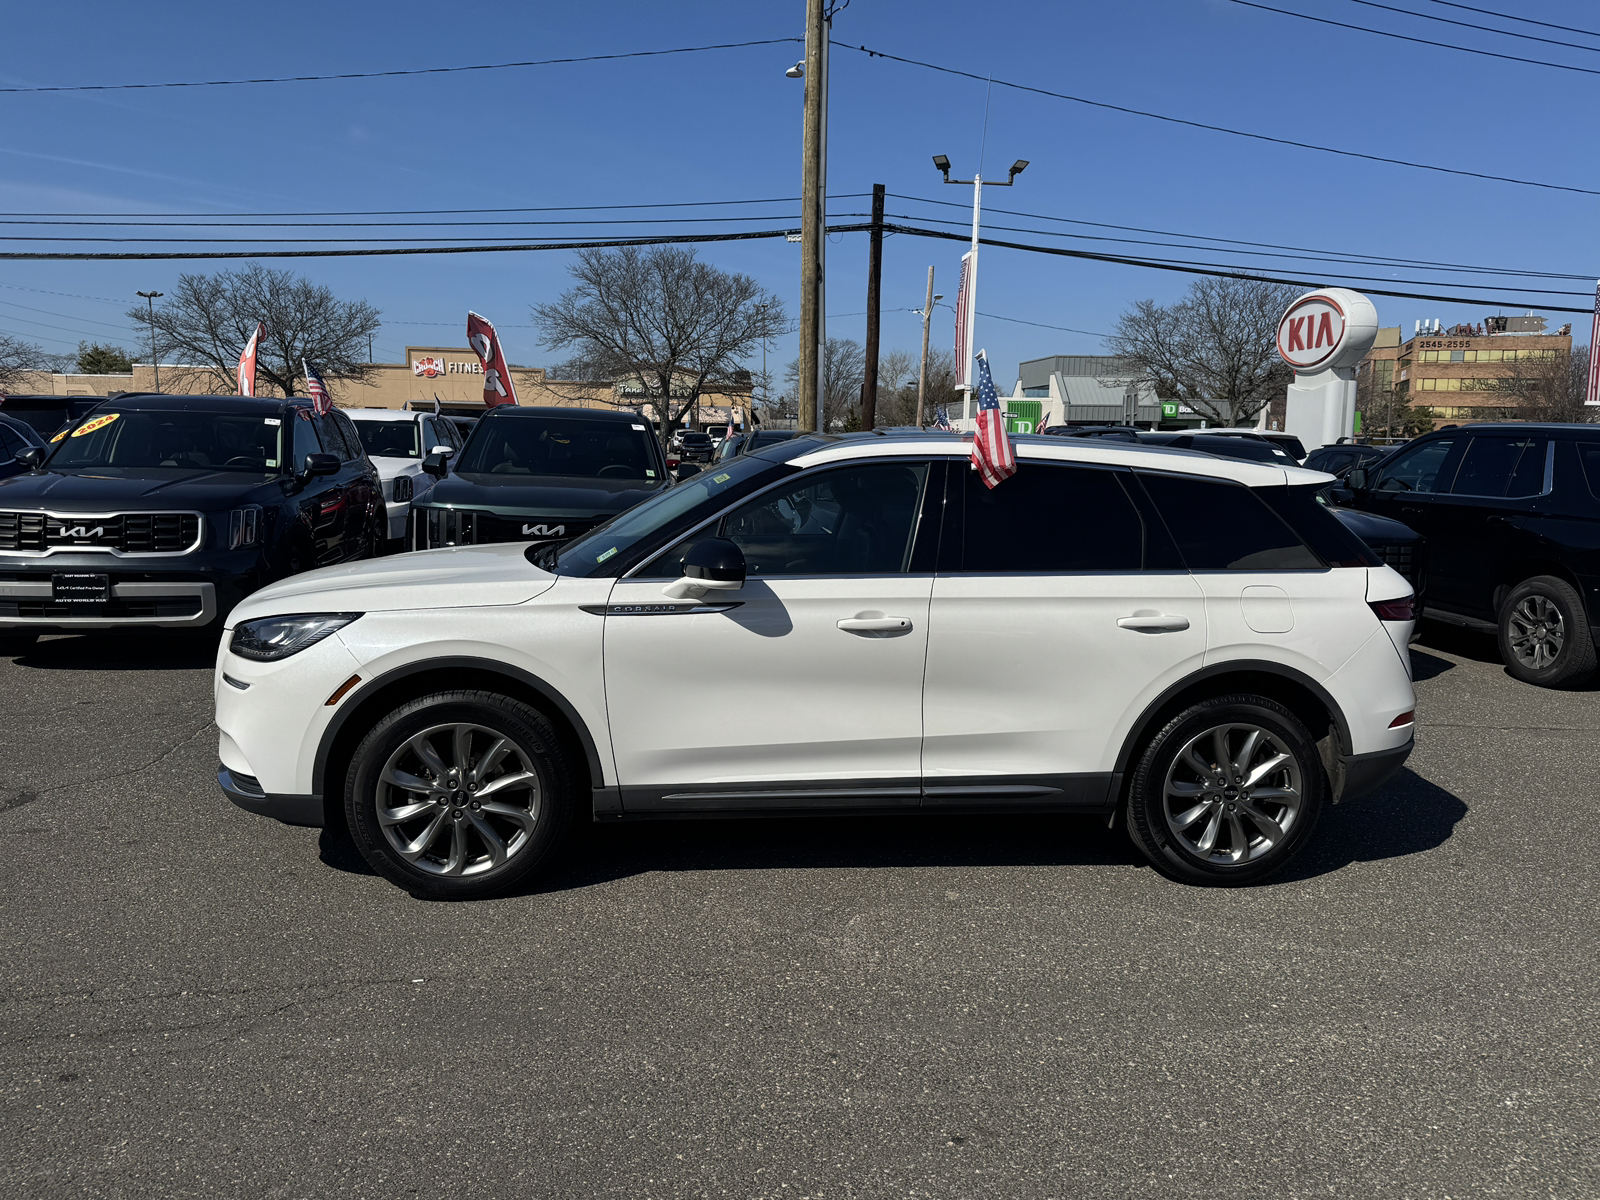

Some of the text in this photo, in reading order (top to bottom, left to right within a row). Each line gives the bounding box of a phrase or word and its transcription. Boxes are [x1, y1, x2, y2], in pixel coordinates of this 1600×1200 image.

[1287, 311, 1335, 352] KIA
[413, 358, 484, 375] CRUNCH FITNES
[1163, 404, 1176, 415] TD
[78, 415, 115, 435] 2024
[1015, 420, 1033, 434] TD
[60, 526, 103, 537] KIA
[522, 523, 565, 536] KIA
[496, 714, 543, 752] MICHELIN
